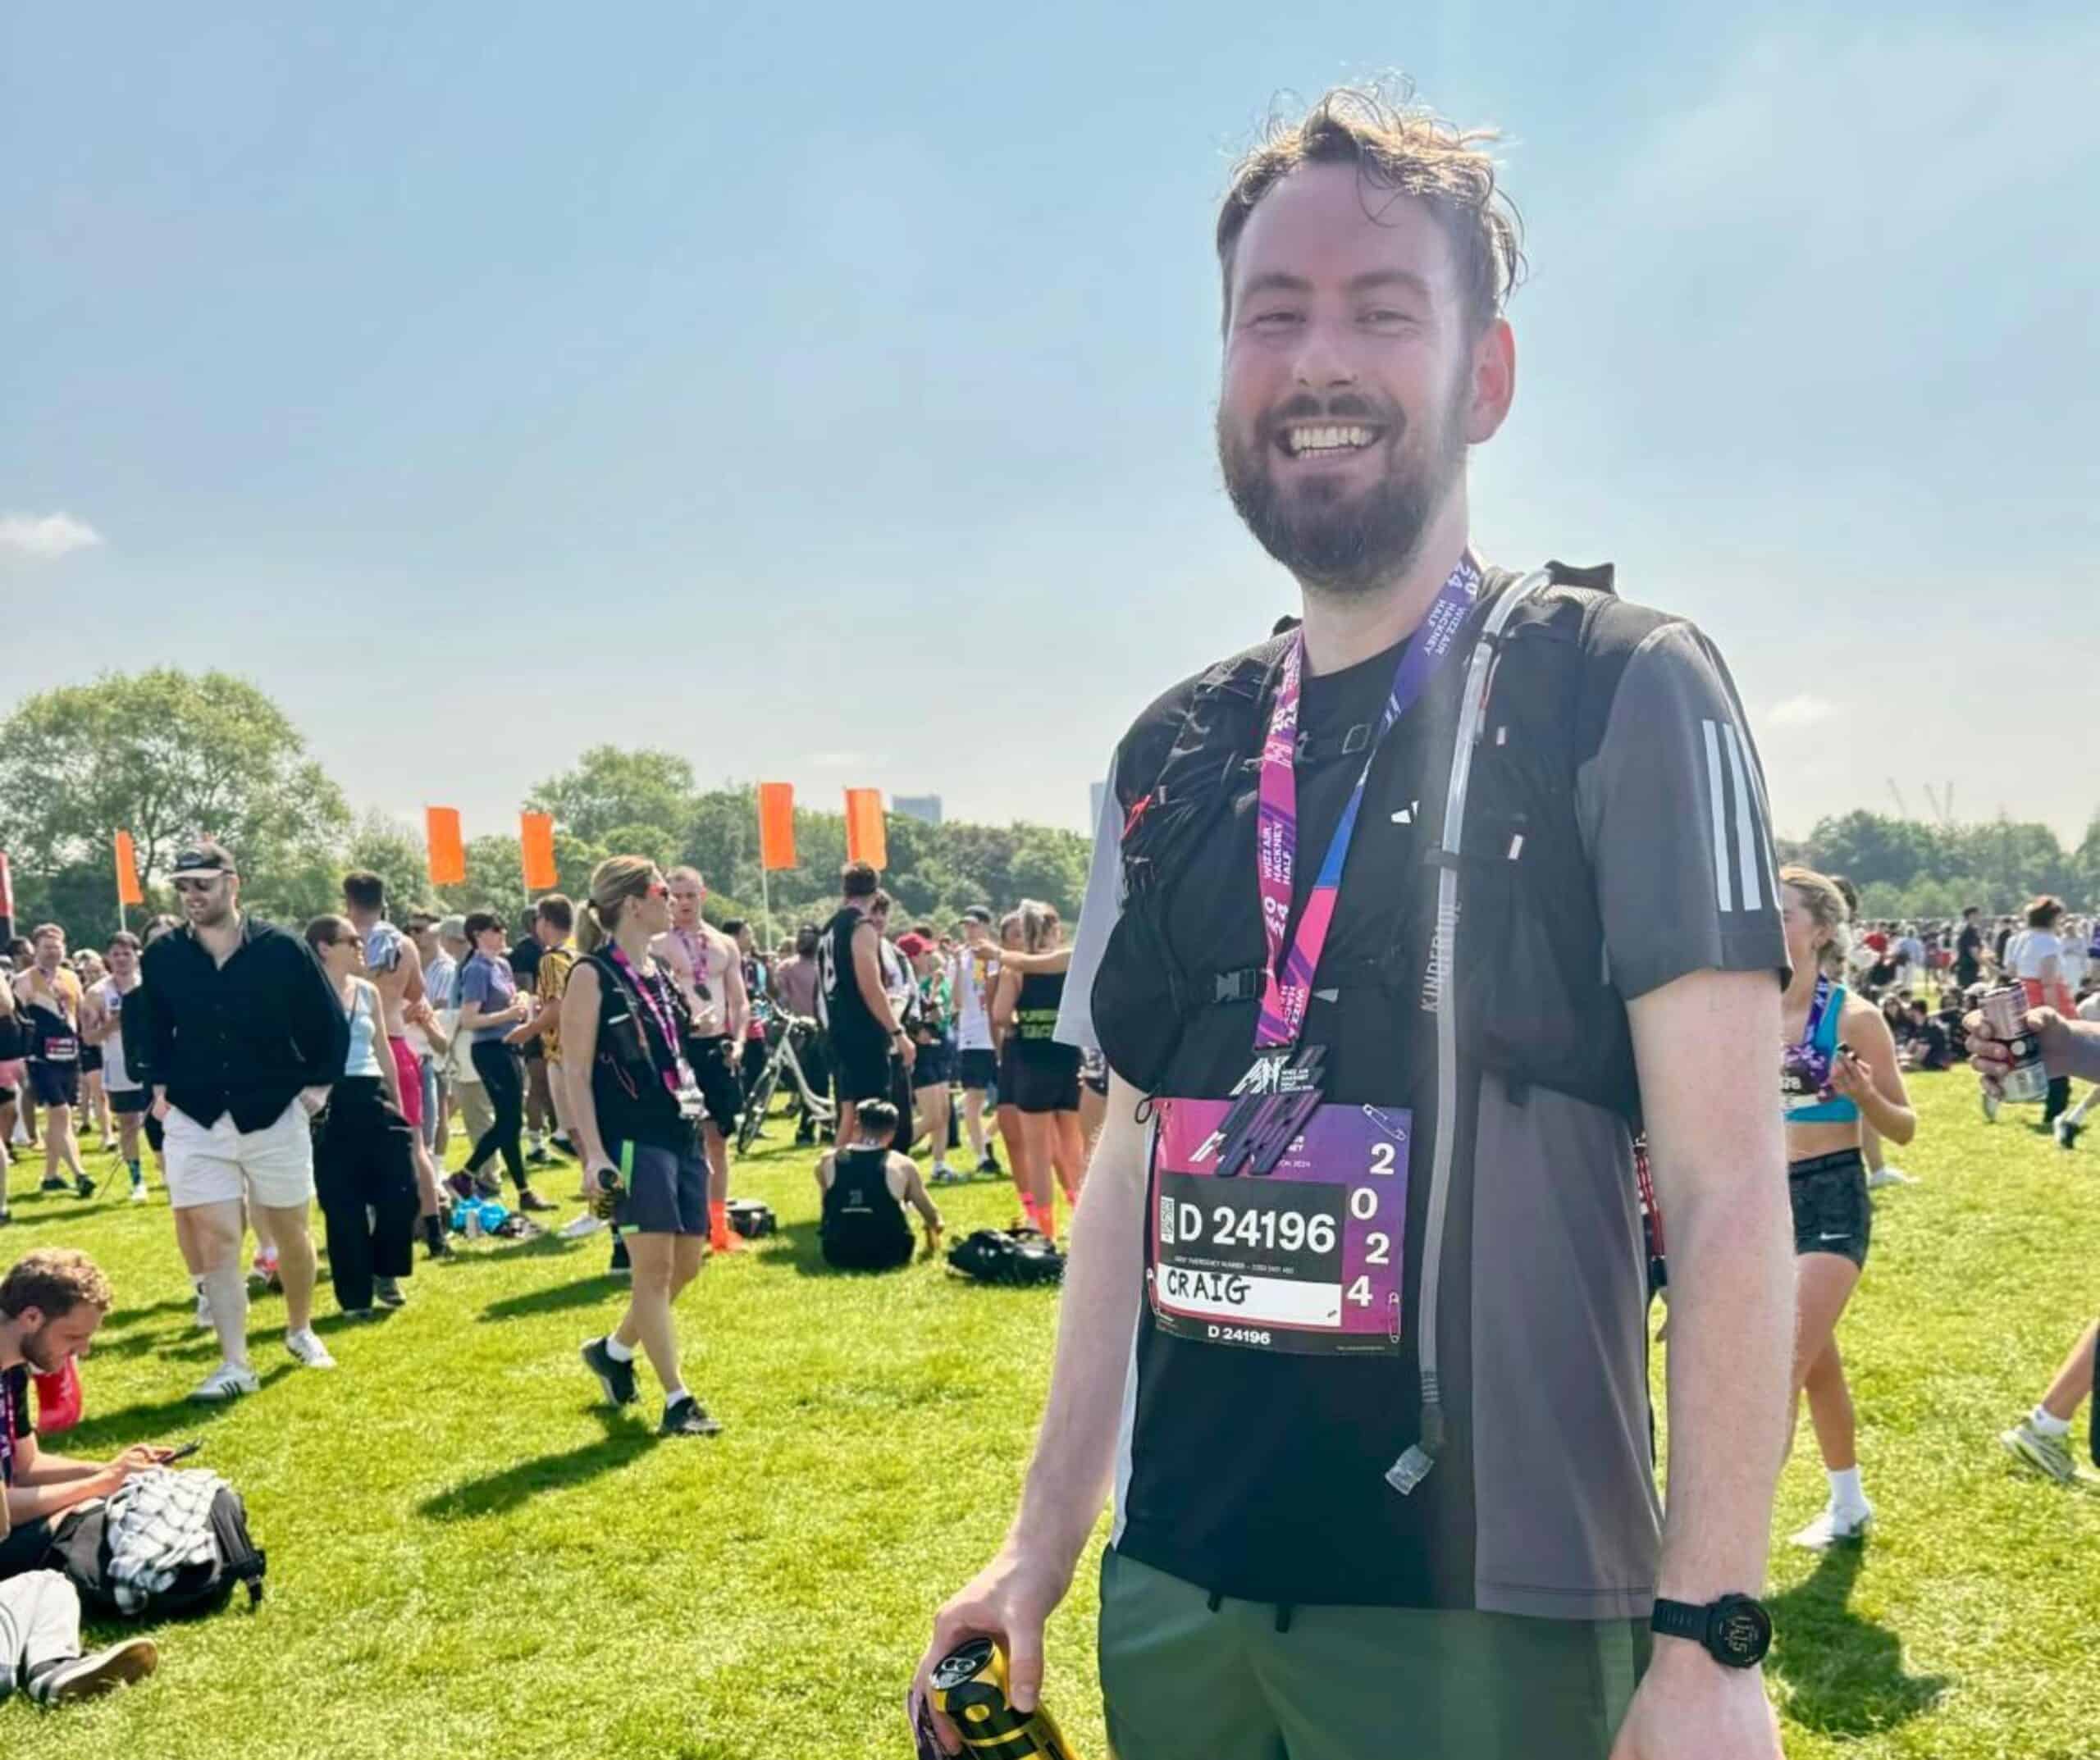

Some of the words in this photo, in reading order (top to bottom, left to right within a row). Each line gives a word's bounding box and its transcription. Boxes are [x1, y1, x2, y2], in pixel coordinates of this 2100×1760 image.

[1423, 602, 1457, 657] HACKNEY
[1429, 599, 1446, 627] HALF
[1435, 634, 1451, 655] AIR
[1263, 827, 1272, 847] AIR
[1273, 820, 1283, 883] HACKNEY
[1263, 849, 1272, 879] WIZZ
[1282, 850, 1291, 886] HALF
[1276, 903, 1290, 939] 24
[1179, 1203, 1203, 1241] D
[1212, 1206, 1335, 1253] 24196
[1166, 1270, 1251, 1305] CRAIG
[1208, 1325, 1219, 1338] D
[1221, 1328, 1271, 1345] 24196
